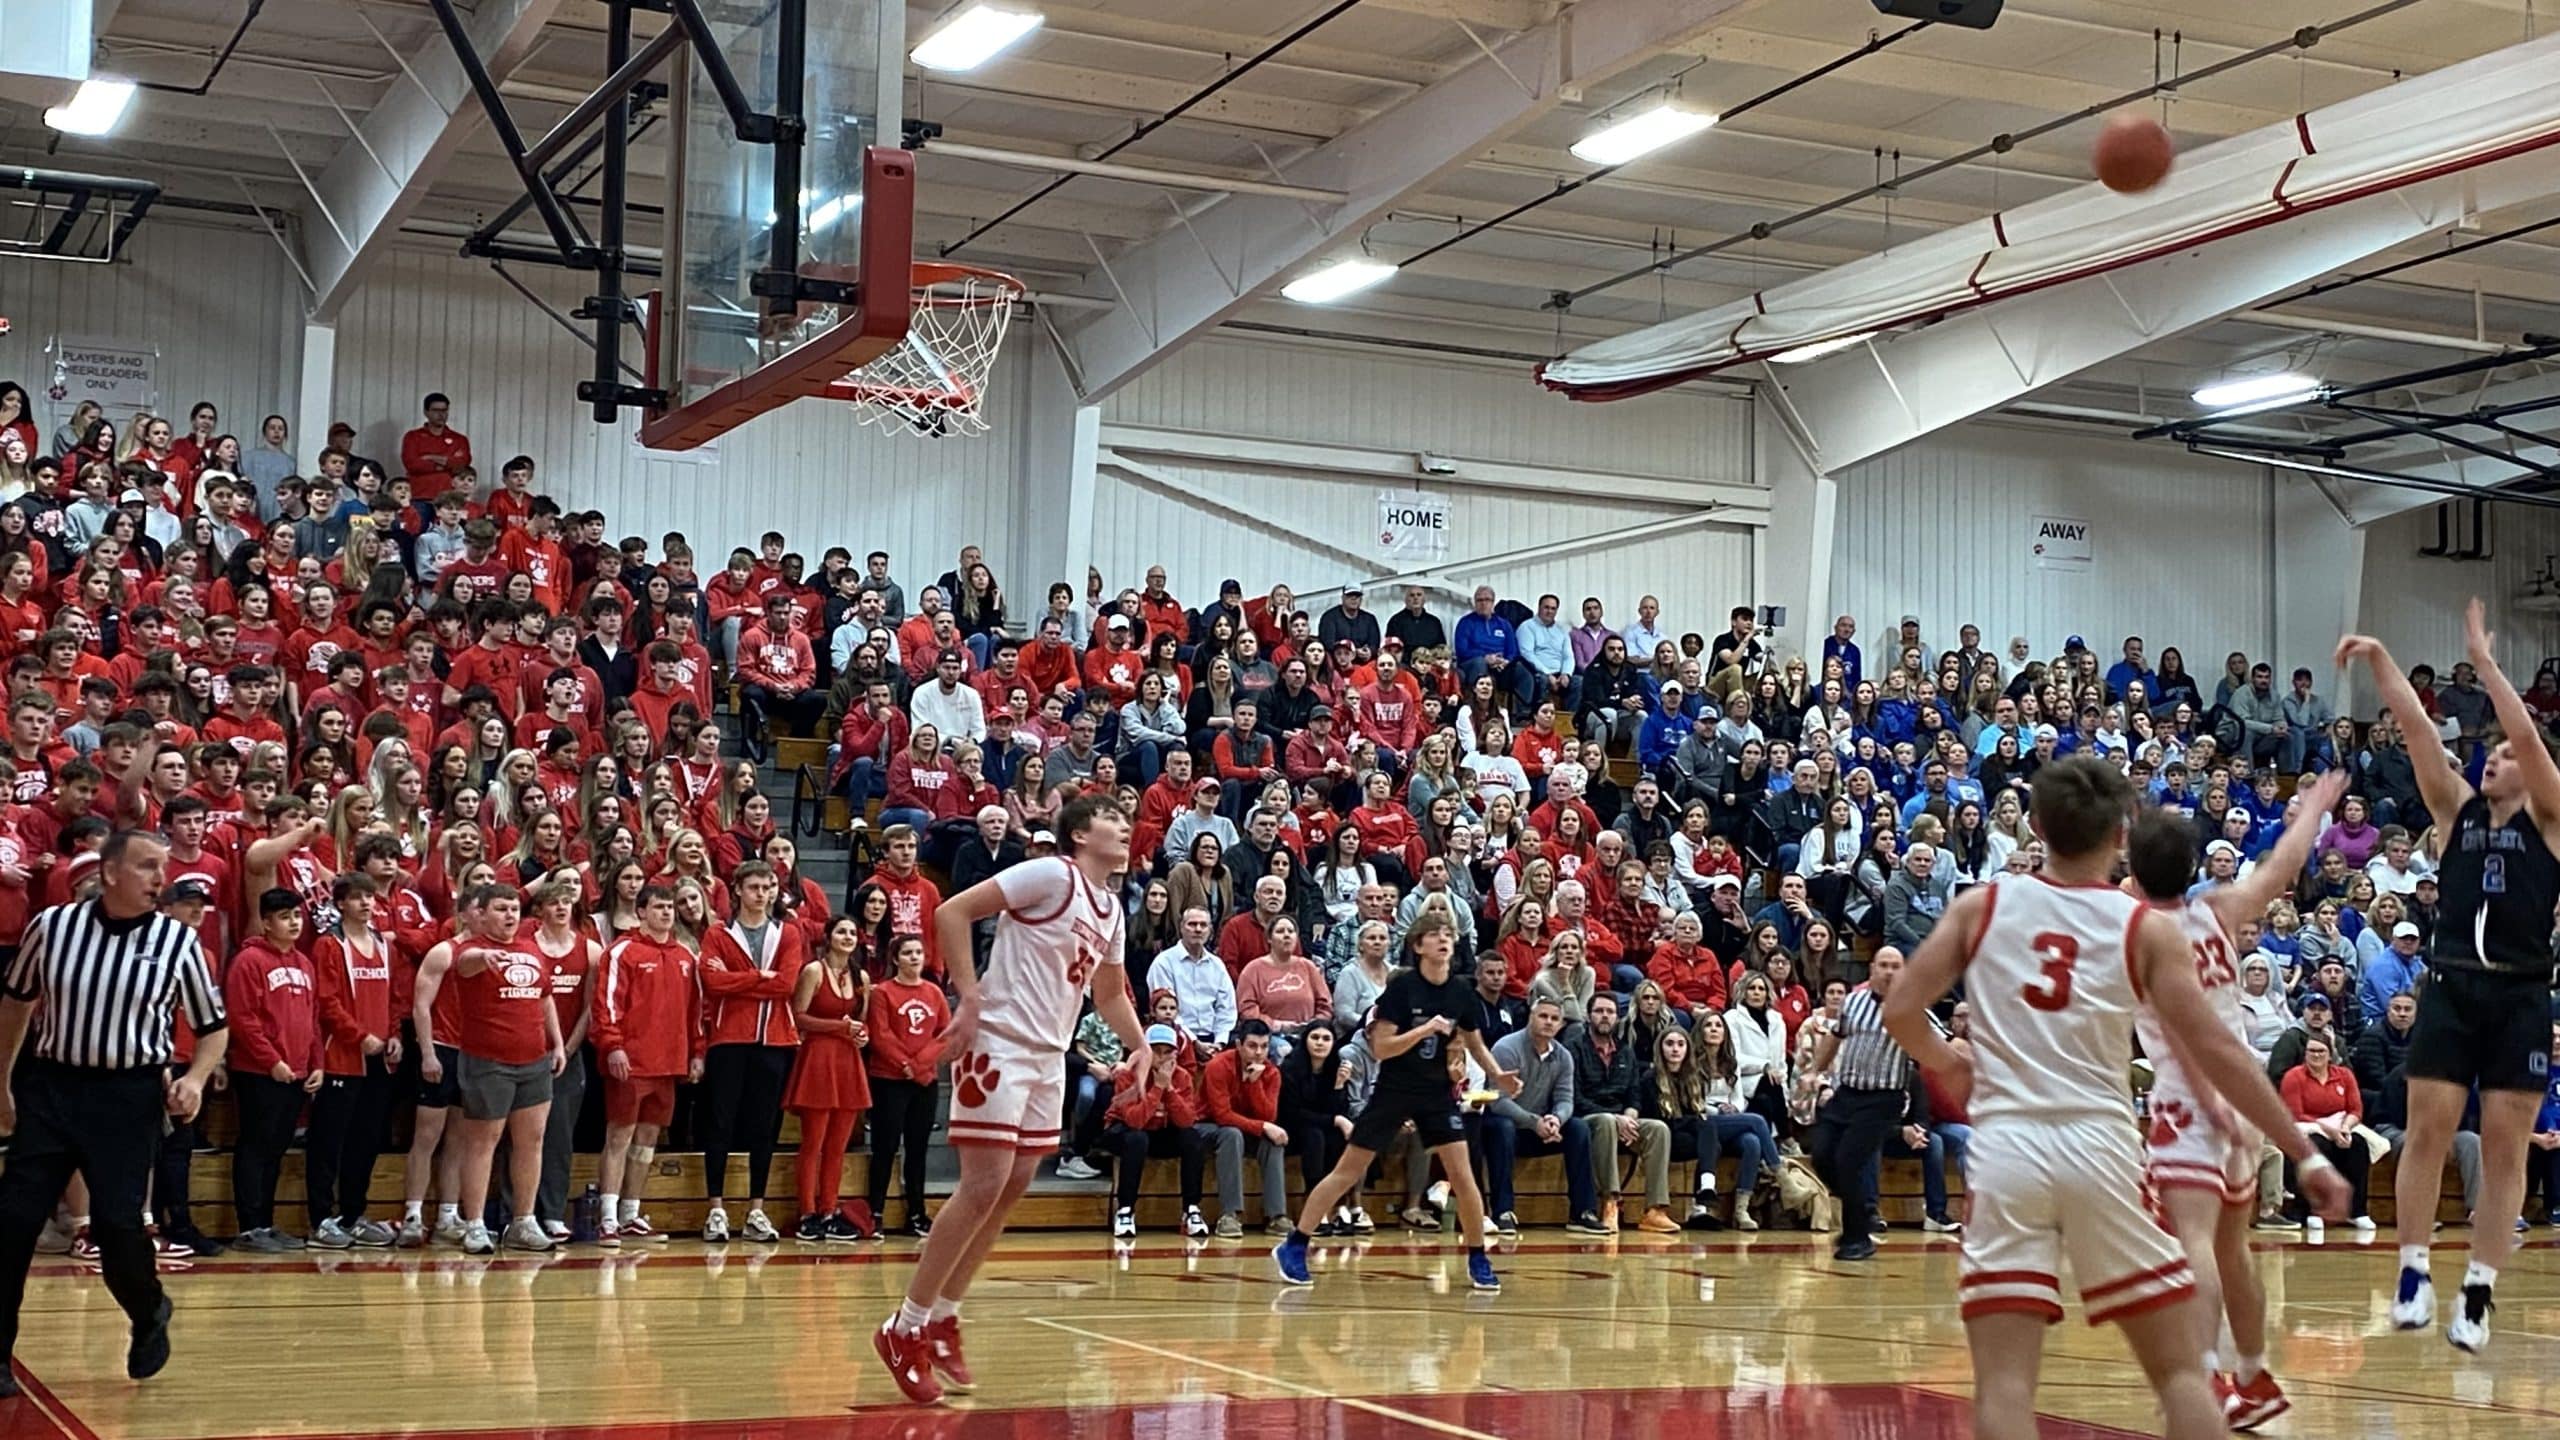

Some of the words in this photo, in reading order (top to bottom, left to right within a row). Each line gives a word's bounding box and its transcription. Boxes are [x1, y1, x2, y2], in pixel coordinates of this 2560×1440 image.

[62, 351, 115, 365] PLAYERS
[118, 357, 142, 367] AND
[56, 364, 148, 380] HEERLEADERS
[85, 379, 117, 390] ONLY
[1387, 507, 1442, 529] HOME
[2039, 521, 2086, 541] AWAY
[2482, 853, 2506, 893] 2
[2023, 930, 2080, 1013] 3
[2192, 935, 2237, 991] 23
